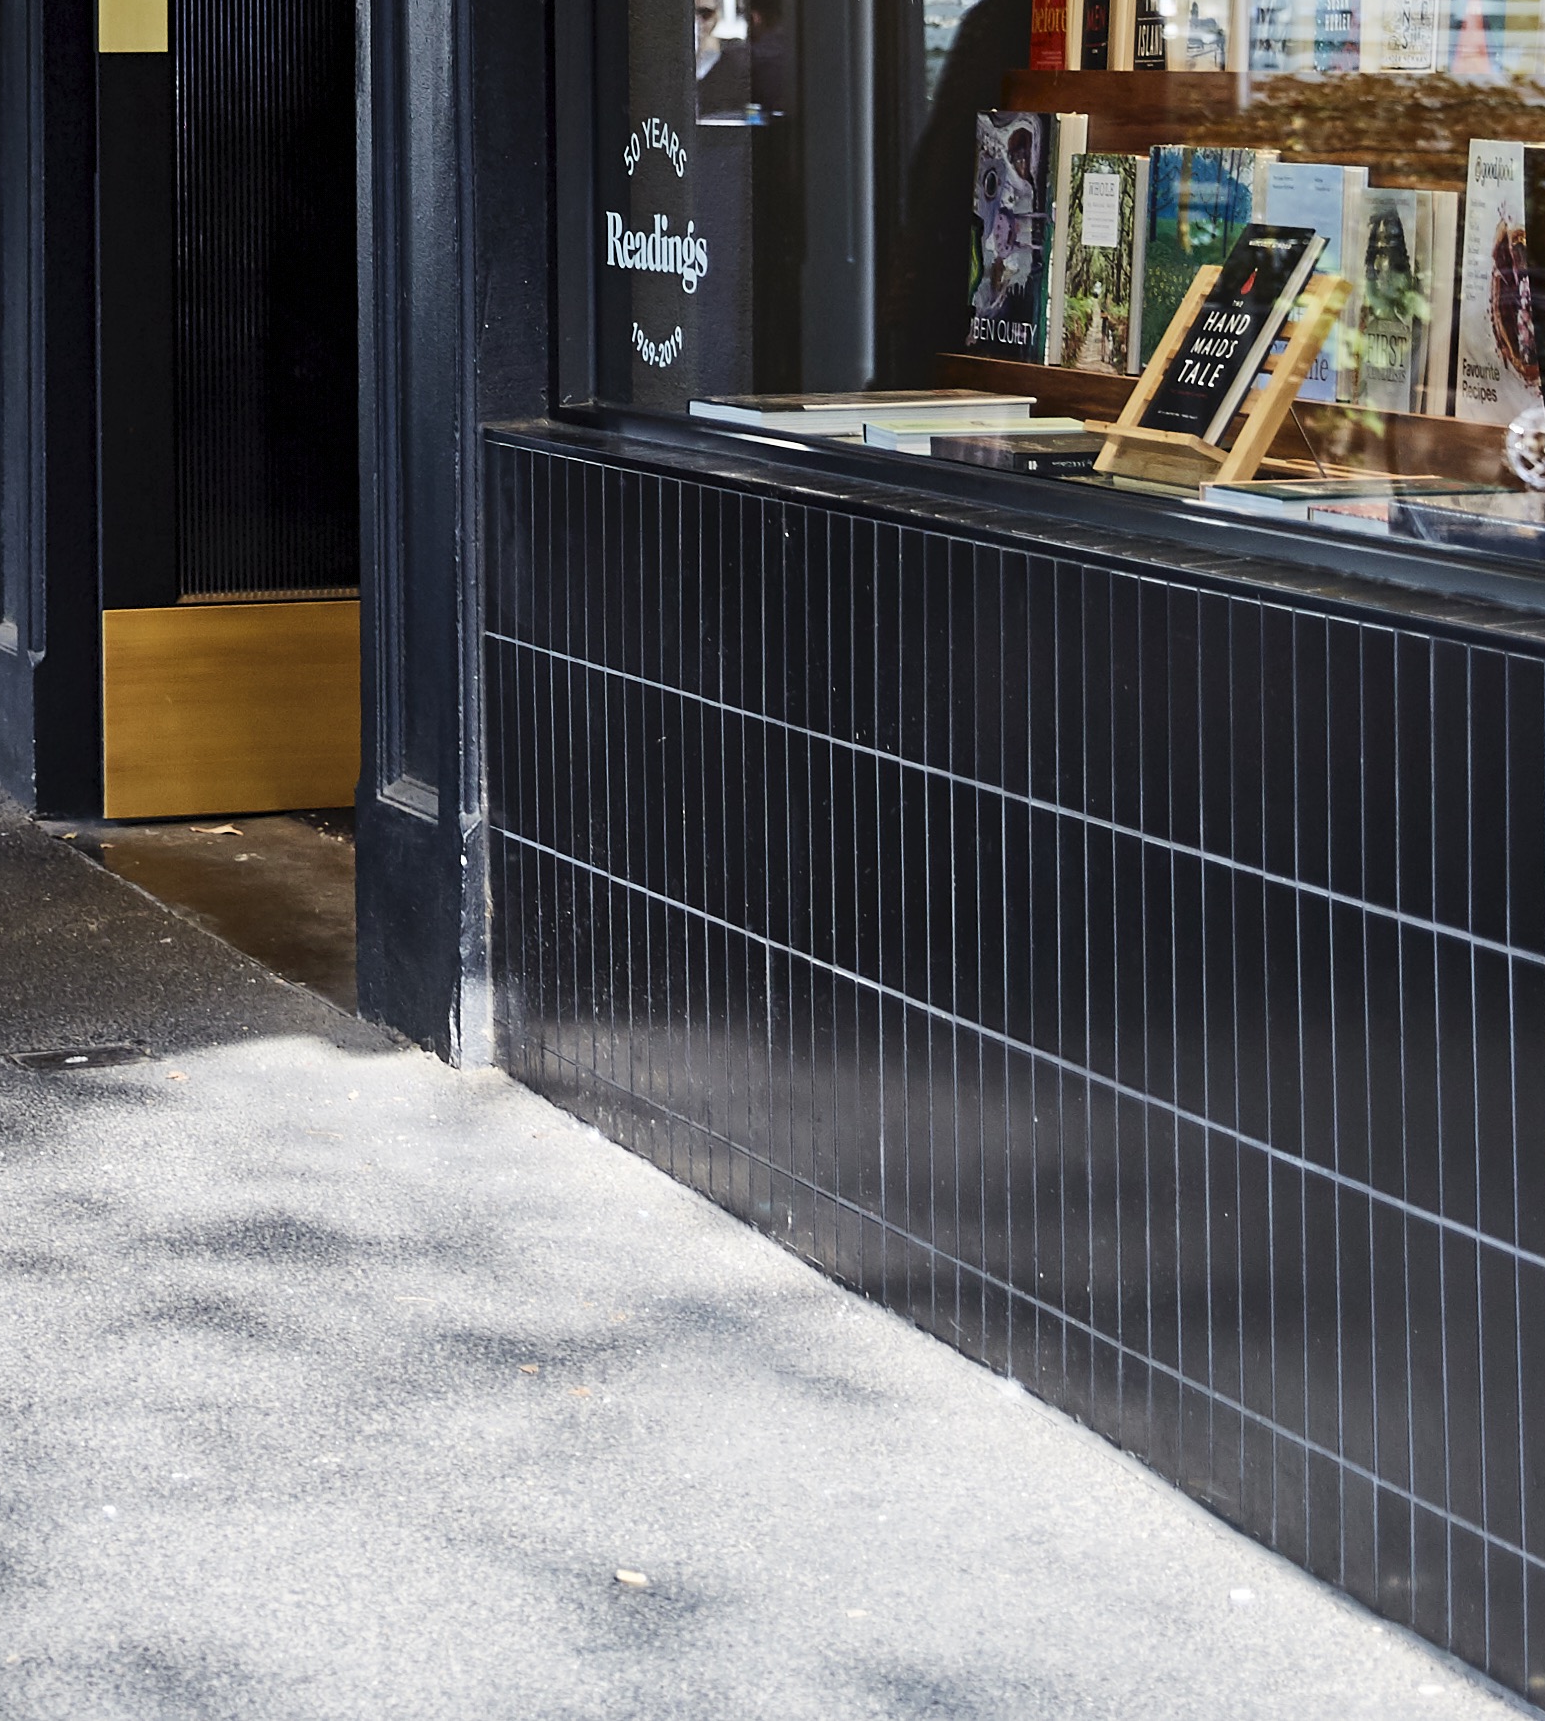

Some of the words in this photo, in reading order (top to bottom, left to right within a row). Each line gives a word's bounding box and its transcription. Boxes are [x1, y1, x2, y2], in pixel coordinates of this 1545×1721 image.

[624, 133, 641, 176] 50
[642, 117, 687, 178] YEARS
[606, 211, 708, 294] Readings
[1233, 299, 1245, 308] THE
[973, 316, 994, 342] BEN
[997, 318, 1037, 347] QUILTY
[1202, 311, 1251, 336] HAND
[631, 322, 683, 368] 1969-2019
[1189, 337, 1239, 359] MAID'S
[1367, 333, 1407, 367] FIRST
[1176, 359, 1225, 389] TALE
[1462, 358, 1500, 381] Favourite
[1462, 380, 1497, 403] Recipes
